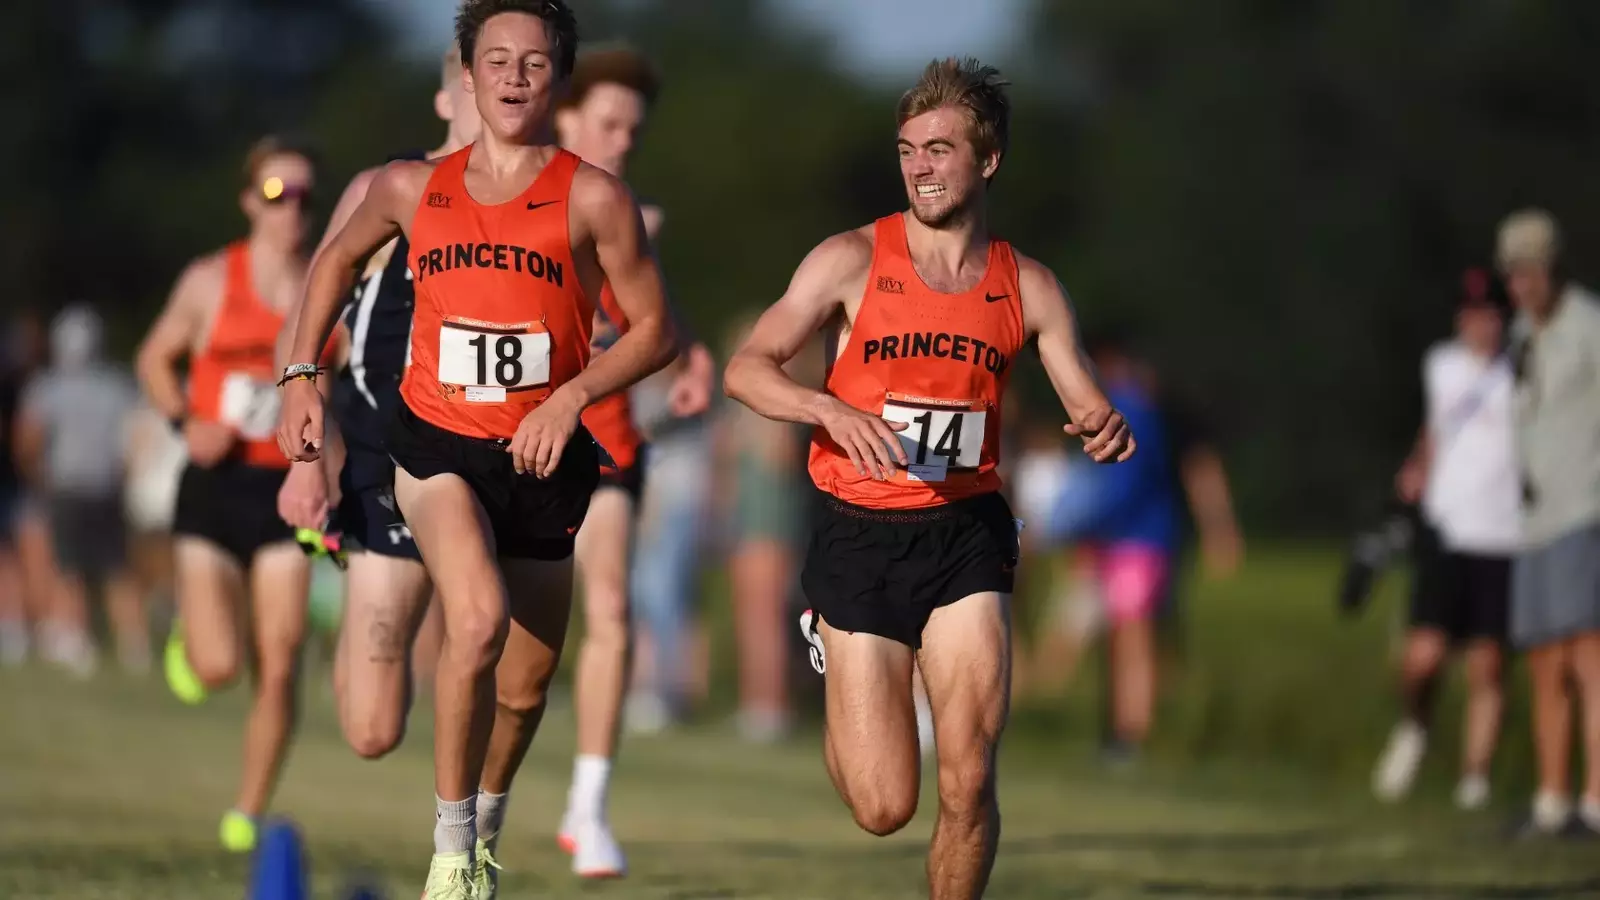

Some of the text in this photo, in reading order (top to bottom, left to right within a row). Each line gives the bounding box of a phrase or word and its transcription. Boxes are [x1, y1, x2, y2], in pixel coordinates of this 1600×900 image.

[418, 243, 563, 288] PRINCETON
[469, 334, 523, 387] 18
[864, 332, 1008, 374] PRINCETON
[904, 395, 934, 405] Princeton
[935, 398, 953, 406] Cross
[913, 411, 963, 466] 14
